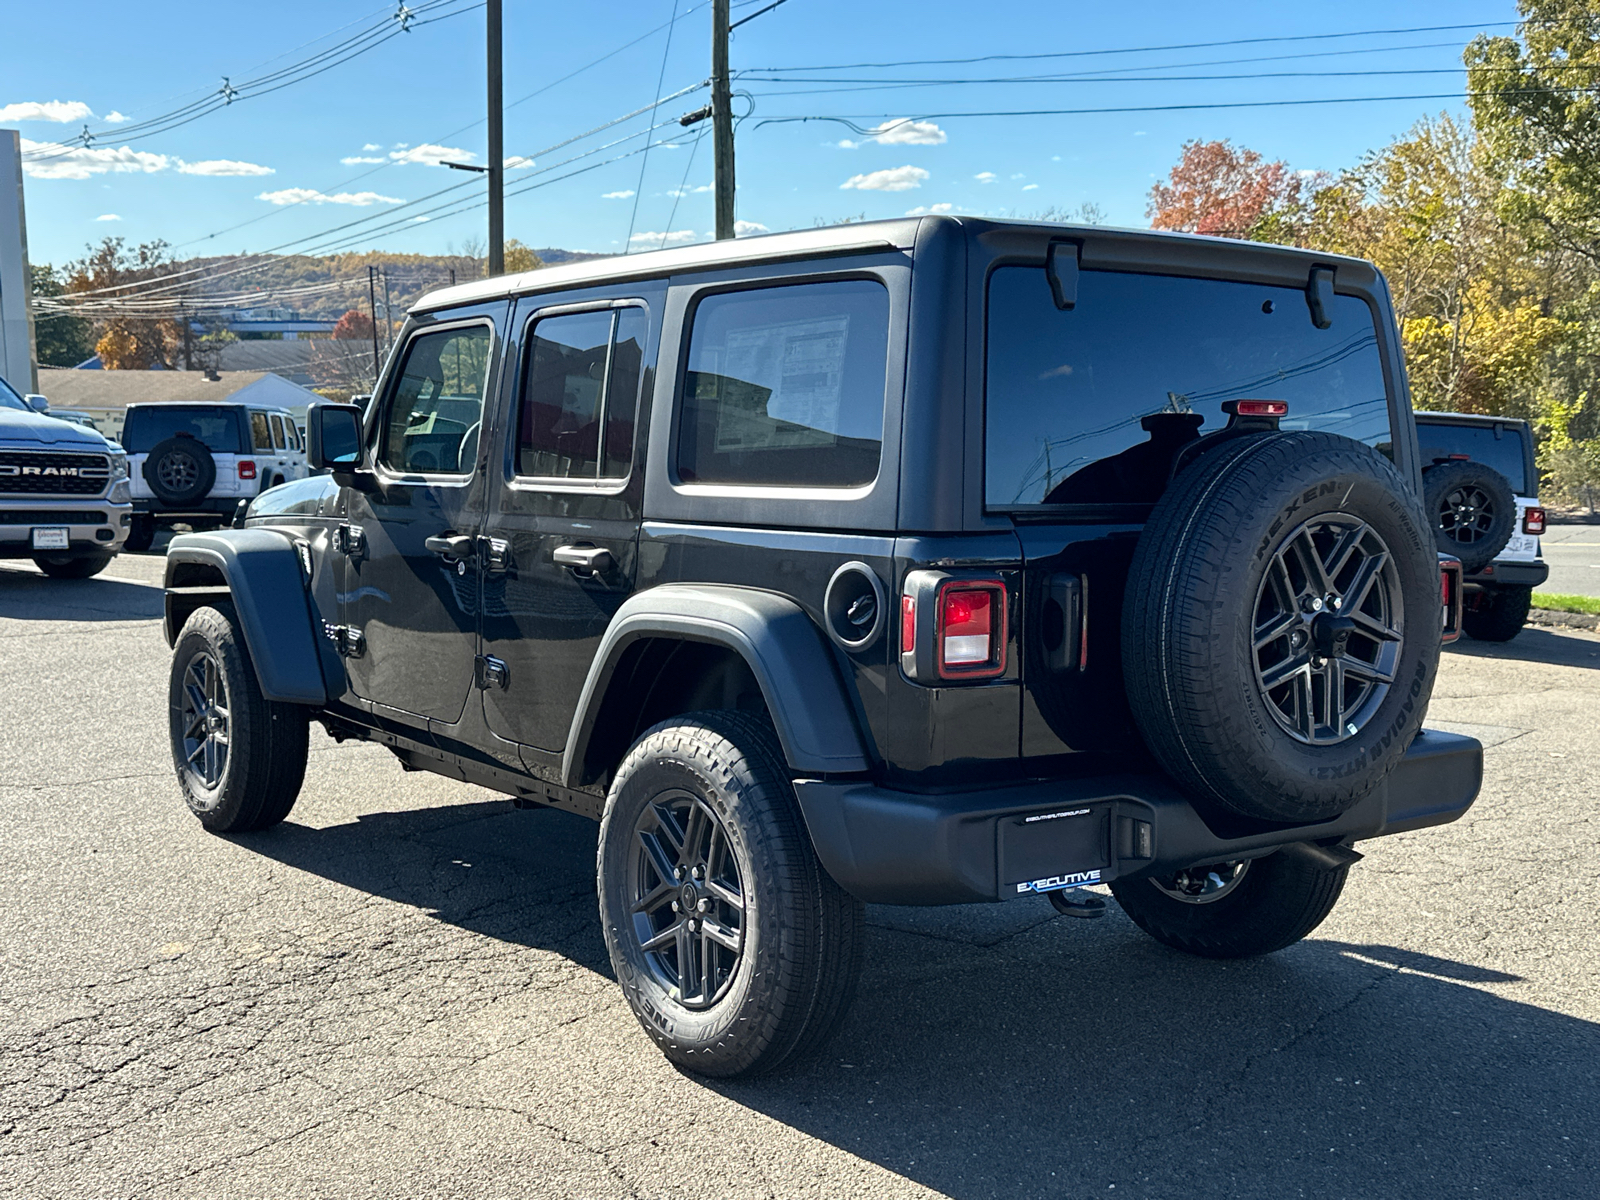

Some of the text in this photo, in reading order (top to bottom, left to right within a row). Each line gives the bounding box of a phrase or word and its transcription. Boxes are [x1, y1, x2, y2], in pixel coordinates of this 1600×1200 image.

[22, 466, 78, 476] RAM
[1256, 480, 1337, 561] NEXEN
[1388, 501, 1421, 551] All-Weather
[1369, 660, 1427, 762] ROADIAN
[1016, 869, 1101, 893] EXECUTIVE
